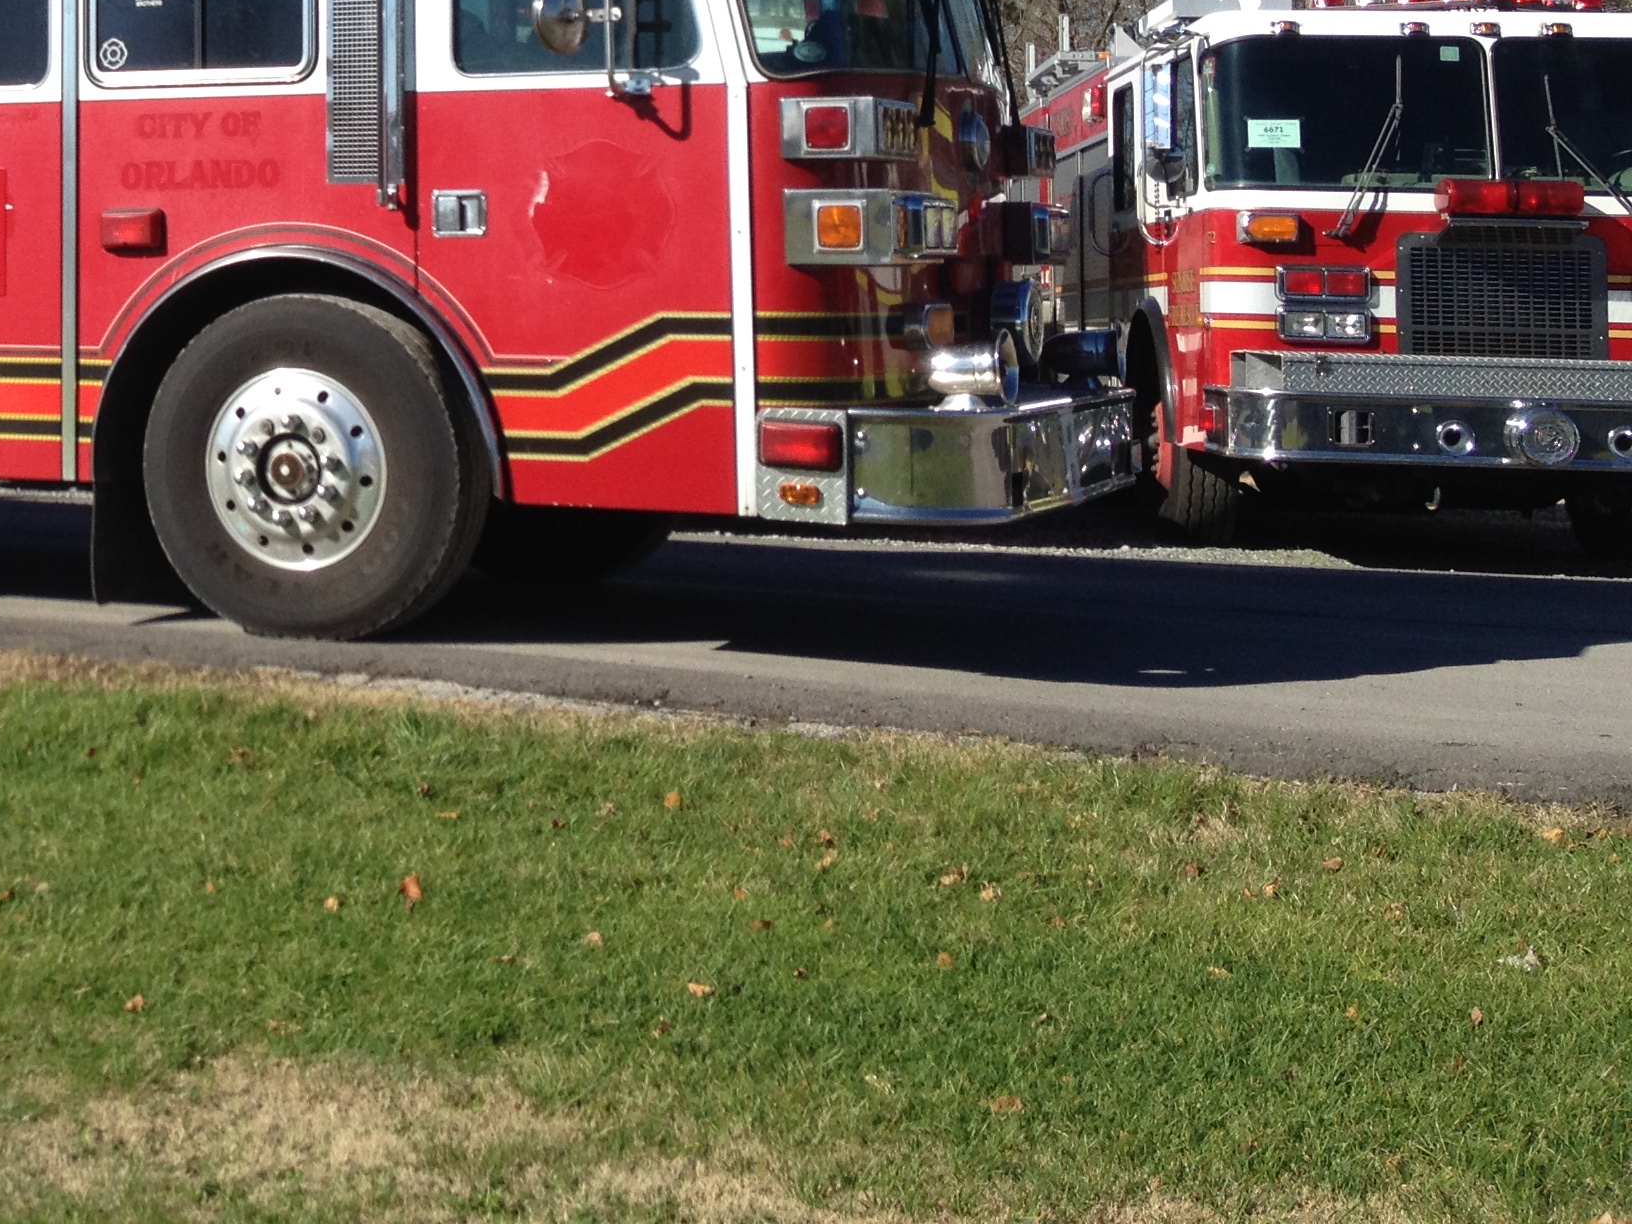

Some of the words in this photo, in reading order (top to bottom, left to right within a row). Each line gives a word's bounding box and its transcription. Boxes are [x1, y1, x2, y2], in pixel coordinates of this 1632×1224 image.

[135, 111, 213, 139] CITY
[221, 111, 262, 137] OF
[120, 158, 280, 191] ORLANDO
